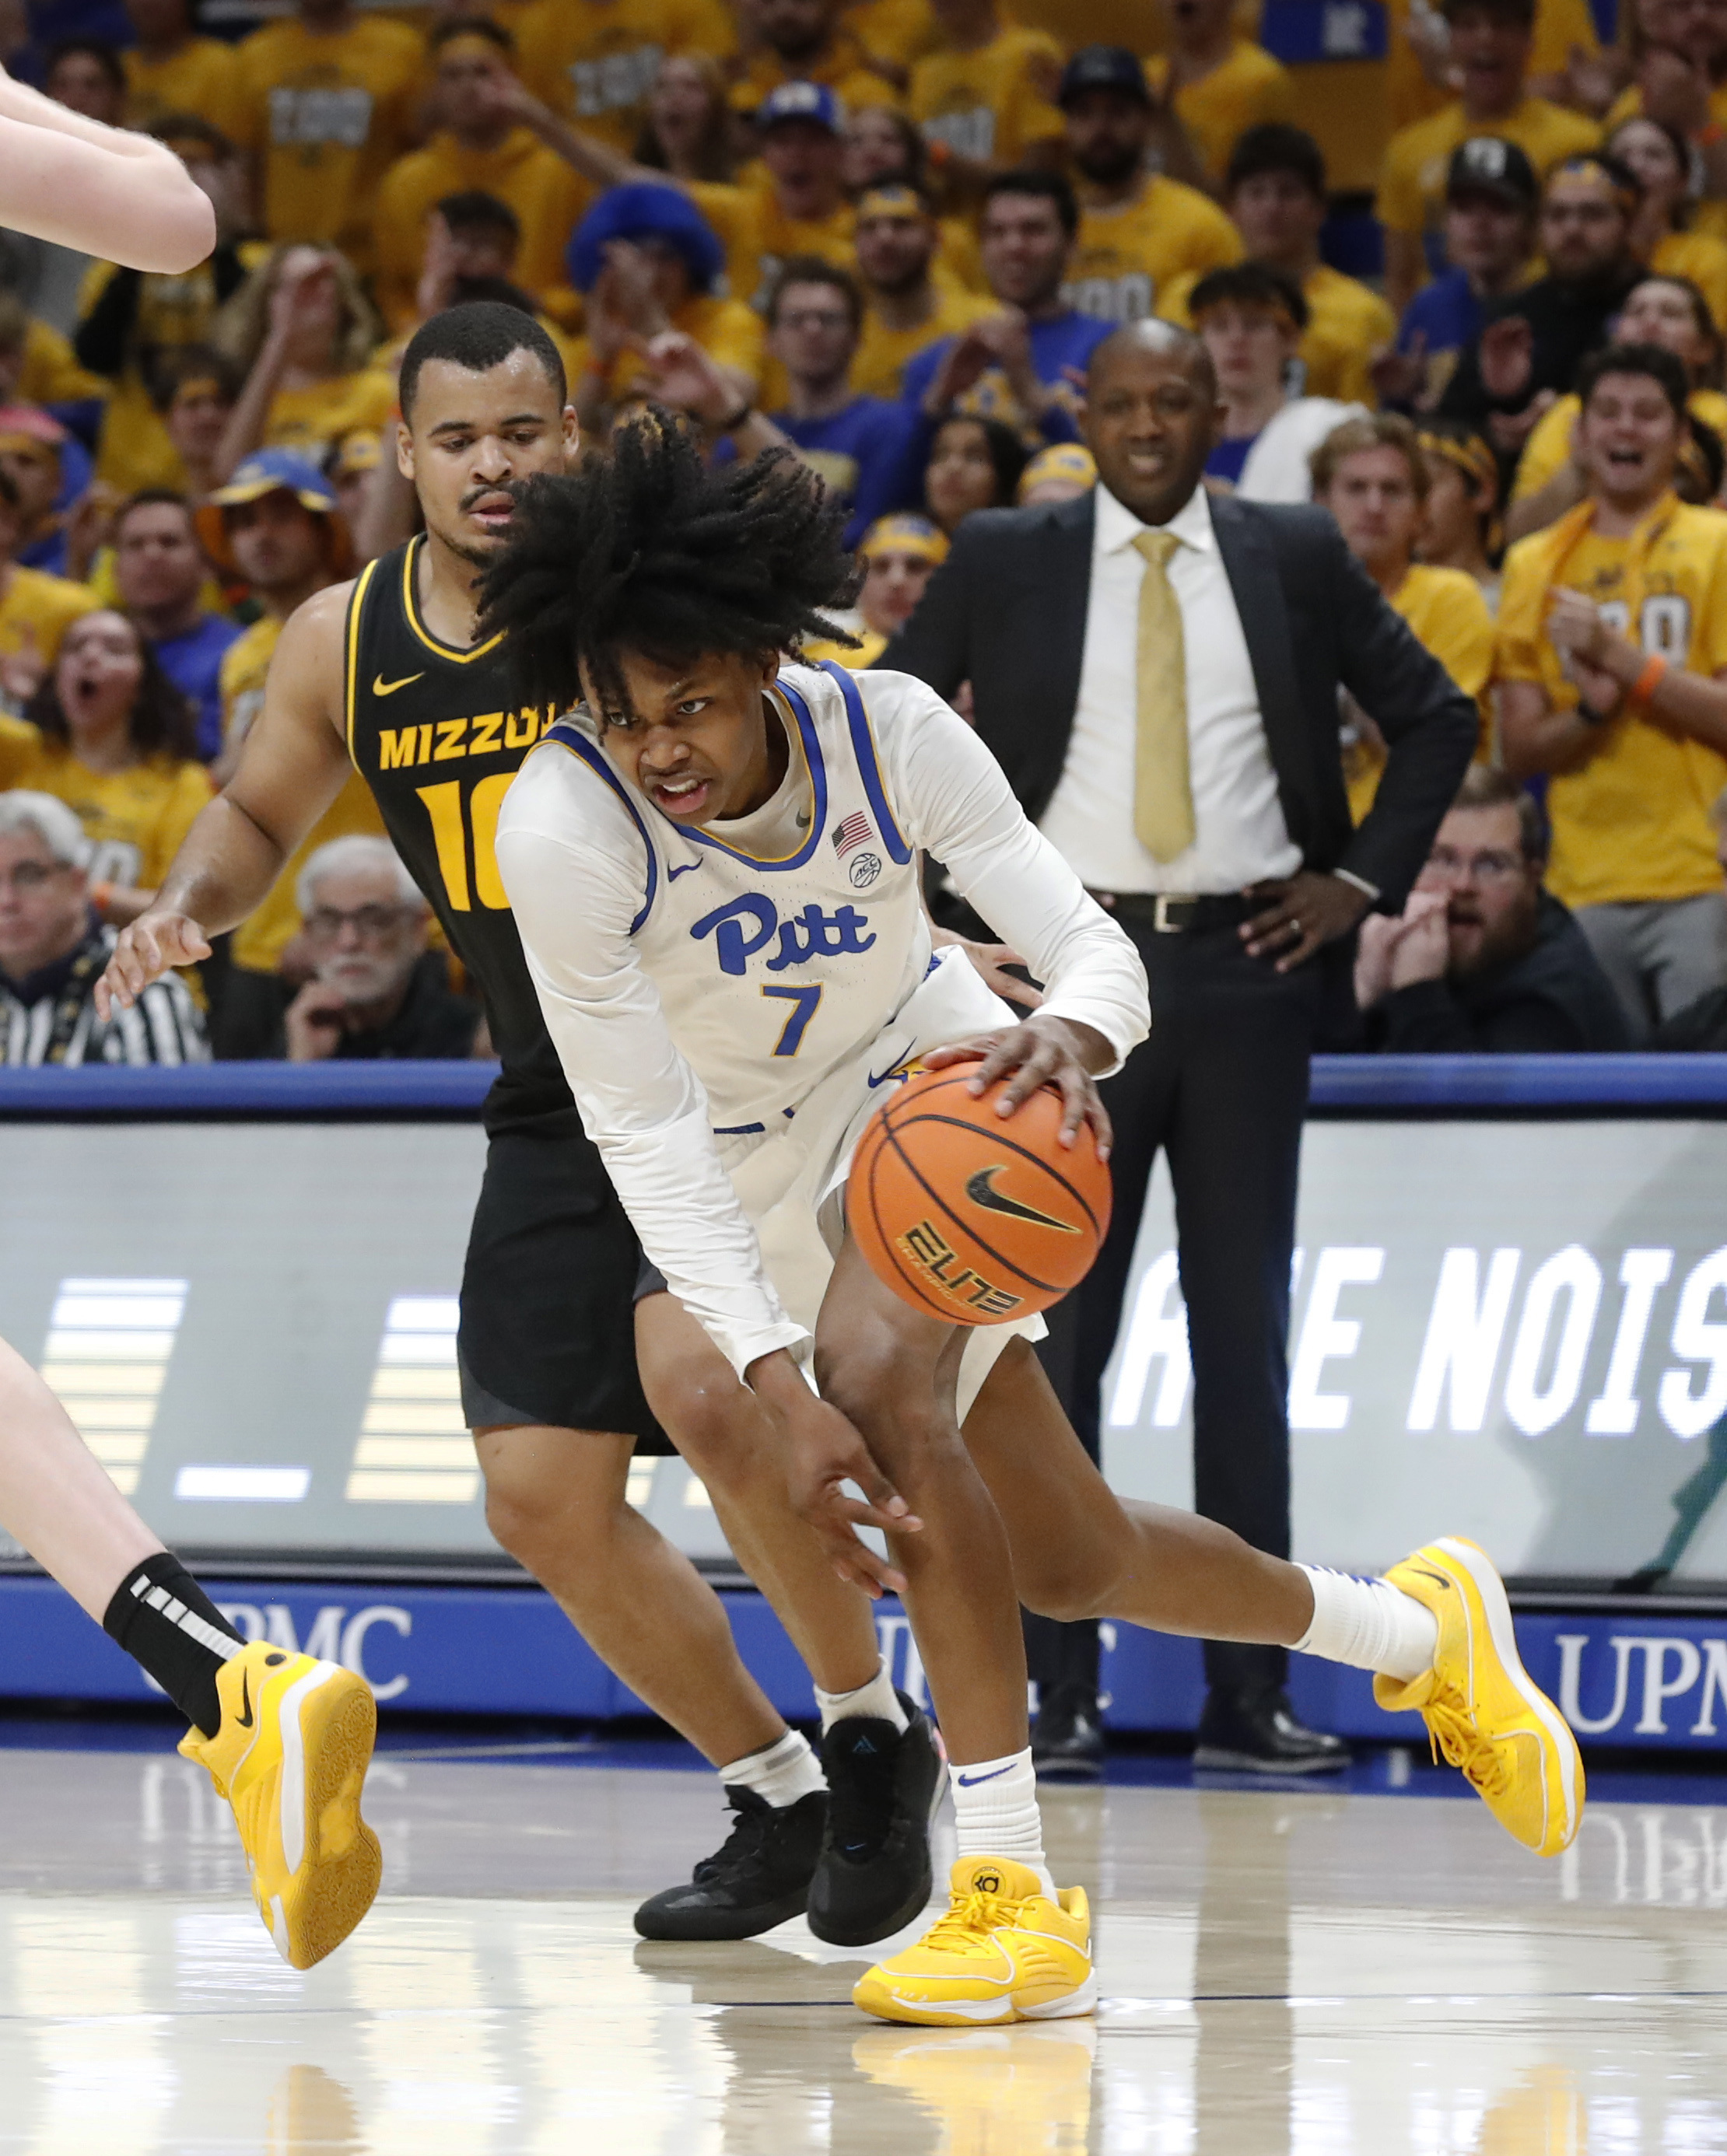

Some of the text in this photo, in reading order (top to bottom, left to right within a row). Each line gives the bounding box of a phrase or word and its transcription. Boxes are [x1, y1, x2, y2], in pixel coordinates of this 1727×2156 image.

[690, 892, 877, 975] Pitt
[760, 982, 825, 1057] 7
[905, 1218, 1025, 1318] ELITE
